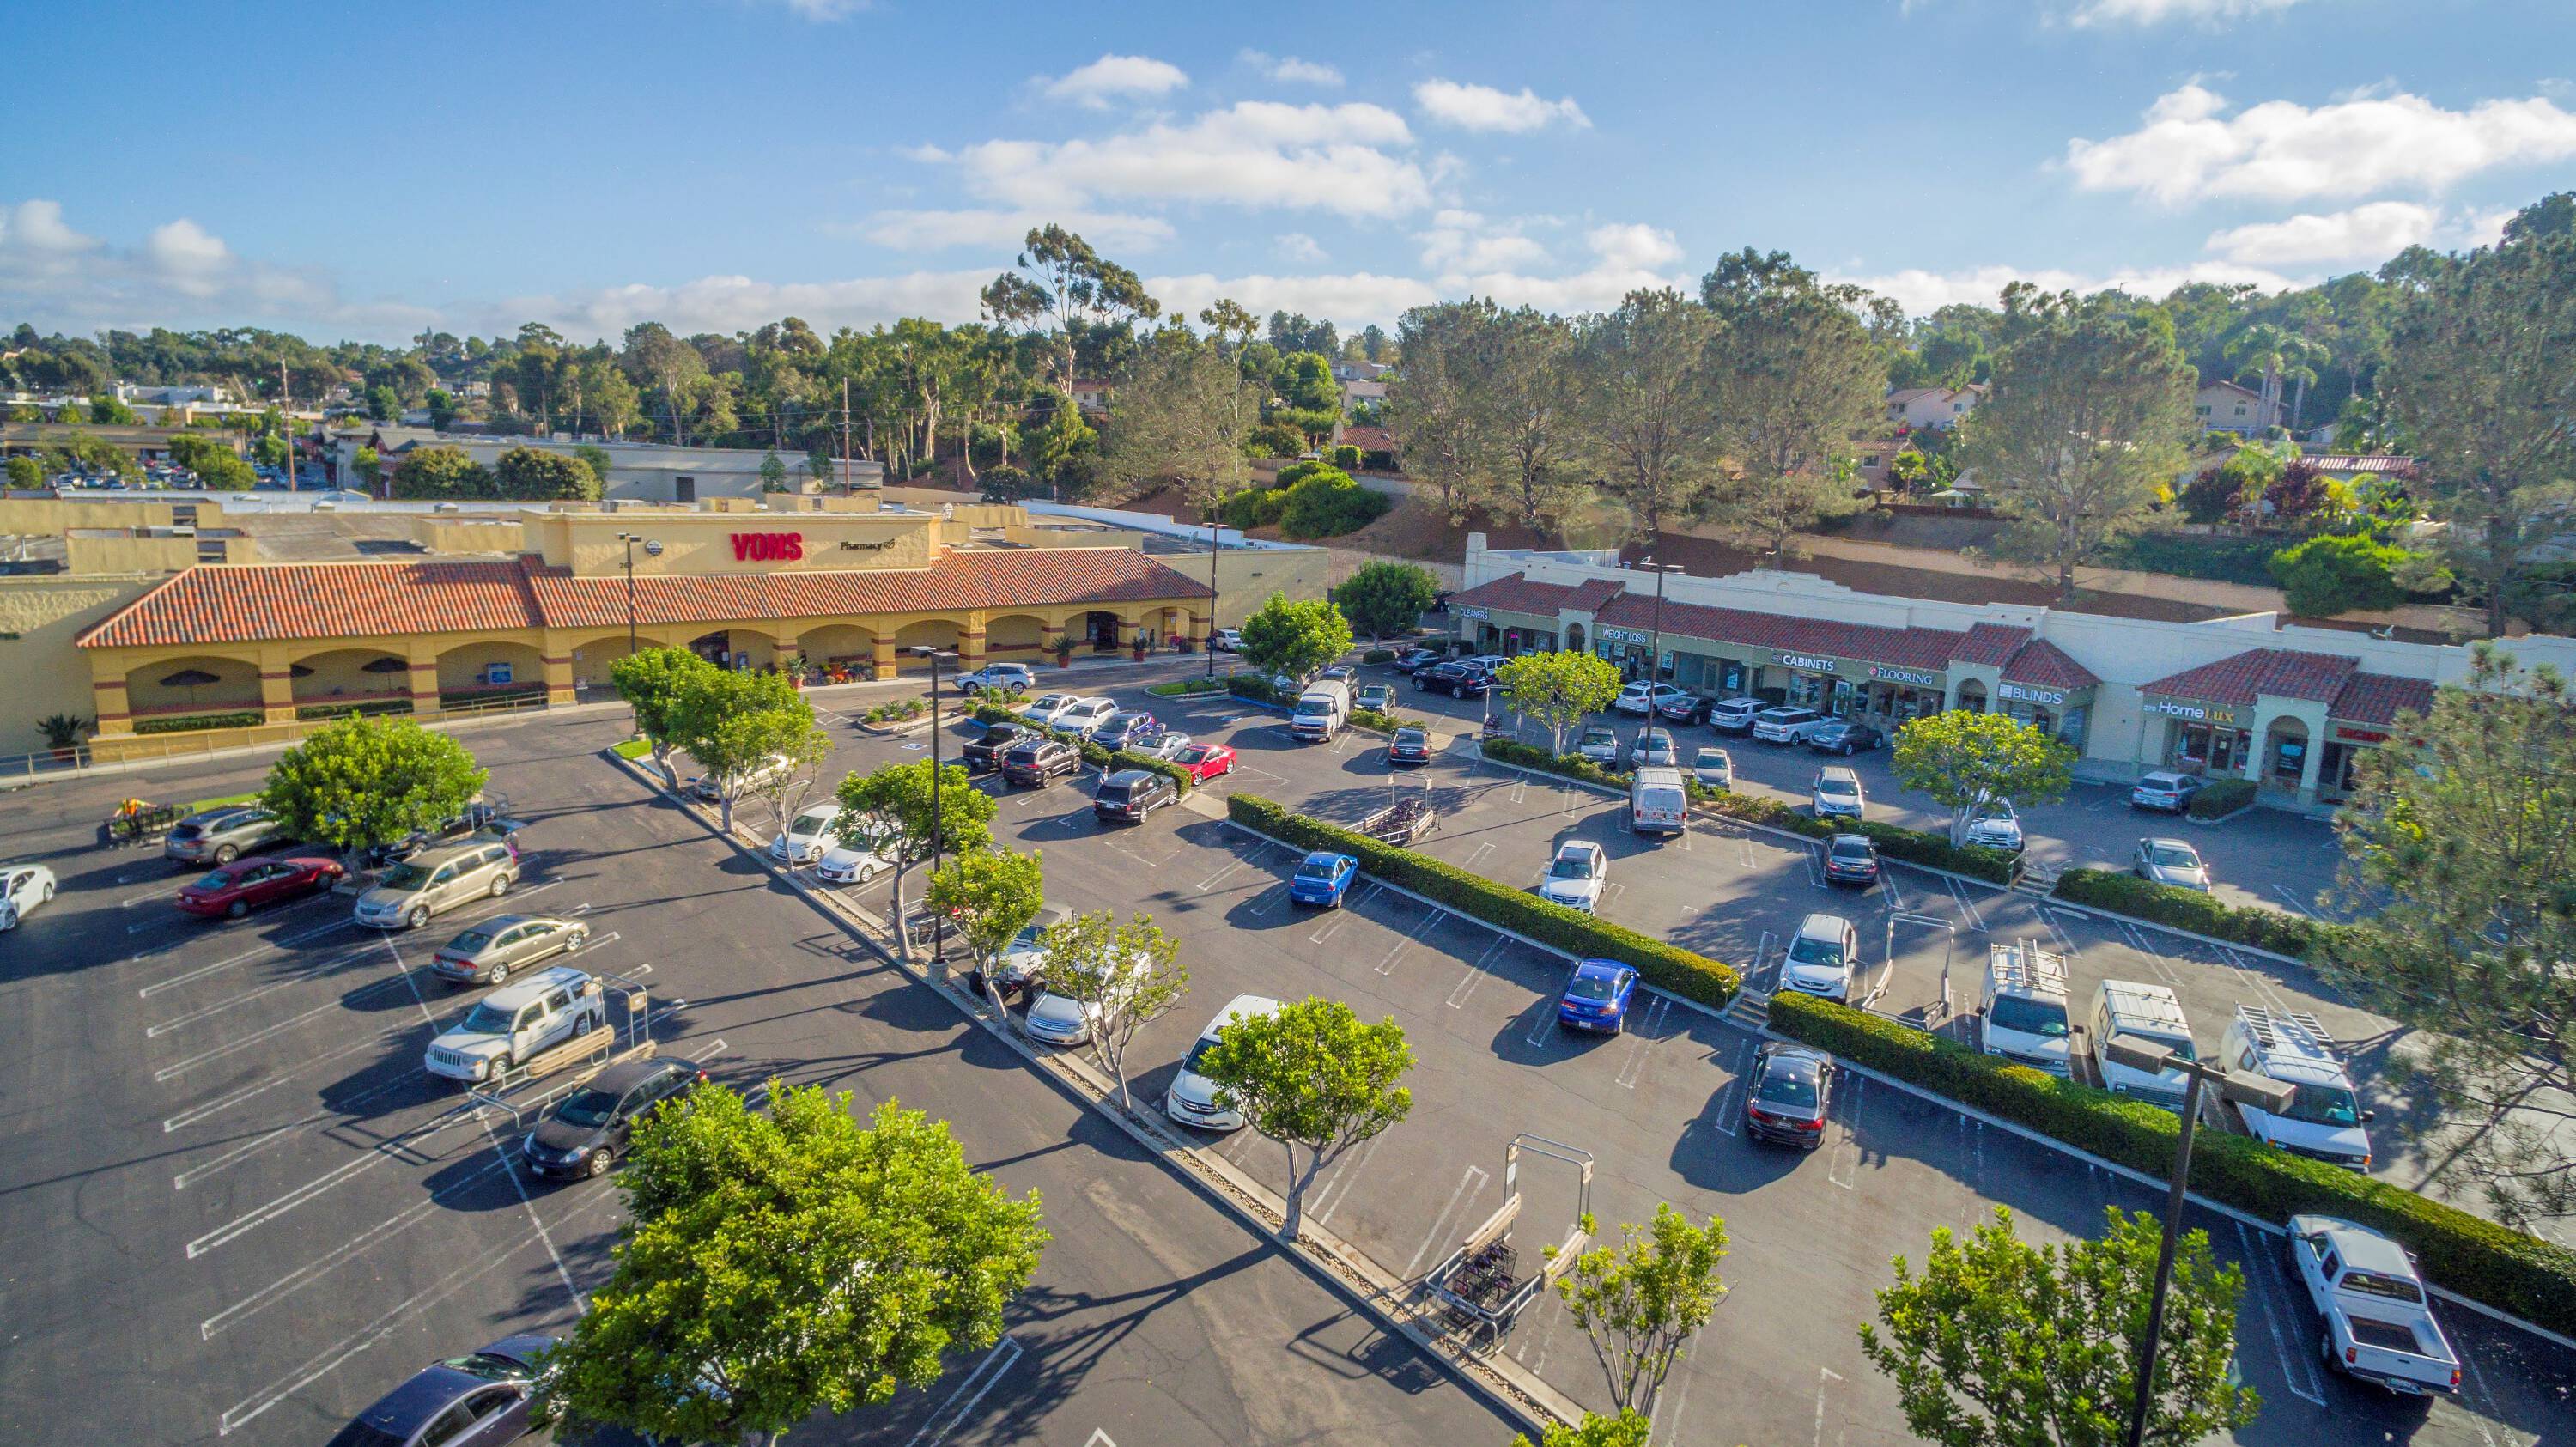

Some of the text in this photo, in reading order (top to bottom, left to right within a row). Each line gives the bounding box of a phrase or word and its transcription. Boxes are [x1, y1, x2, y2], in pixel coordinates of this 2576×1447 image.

[730, 532, 803, 562] VONS
[841, 541, 882, 551] Pharmacy
[1461, 608, 1488, 619] CLEANERS
[1602, 628, 1646, 643] WEIGHT LOSS
[1783, 655, 1834, 671] CABINETS
[1878, 667, 1932, 684] FLOORING
[2013, 687, 2063, 704] BLINDS
